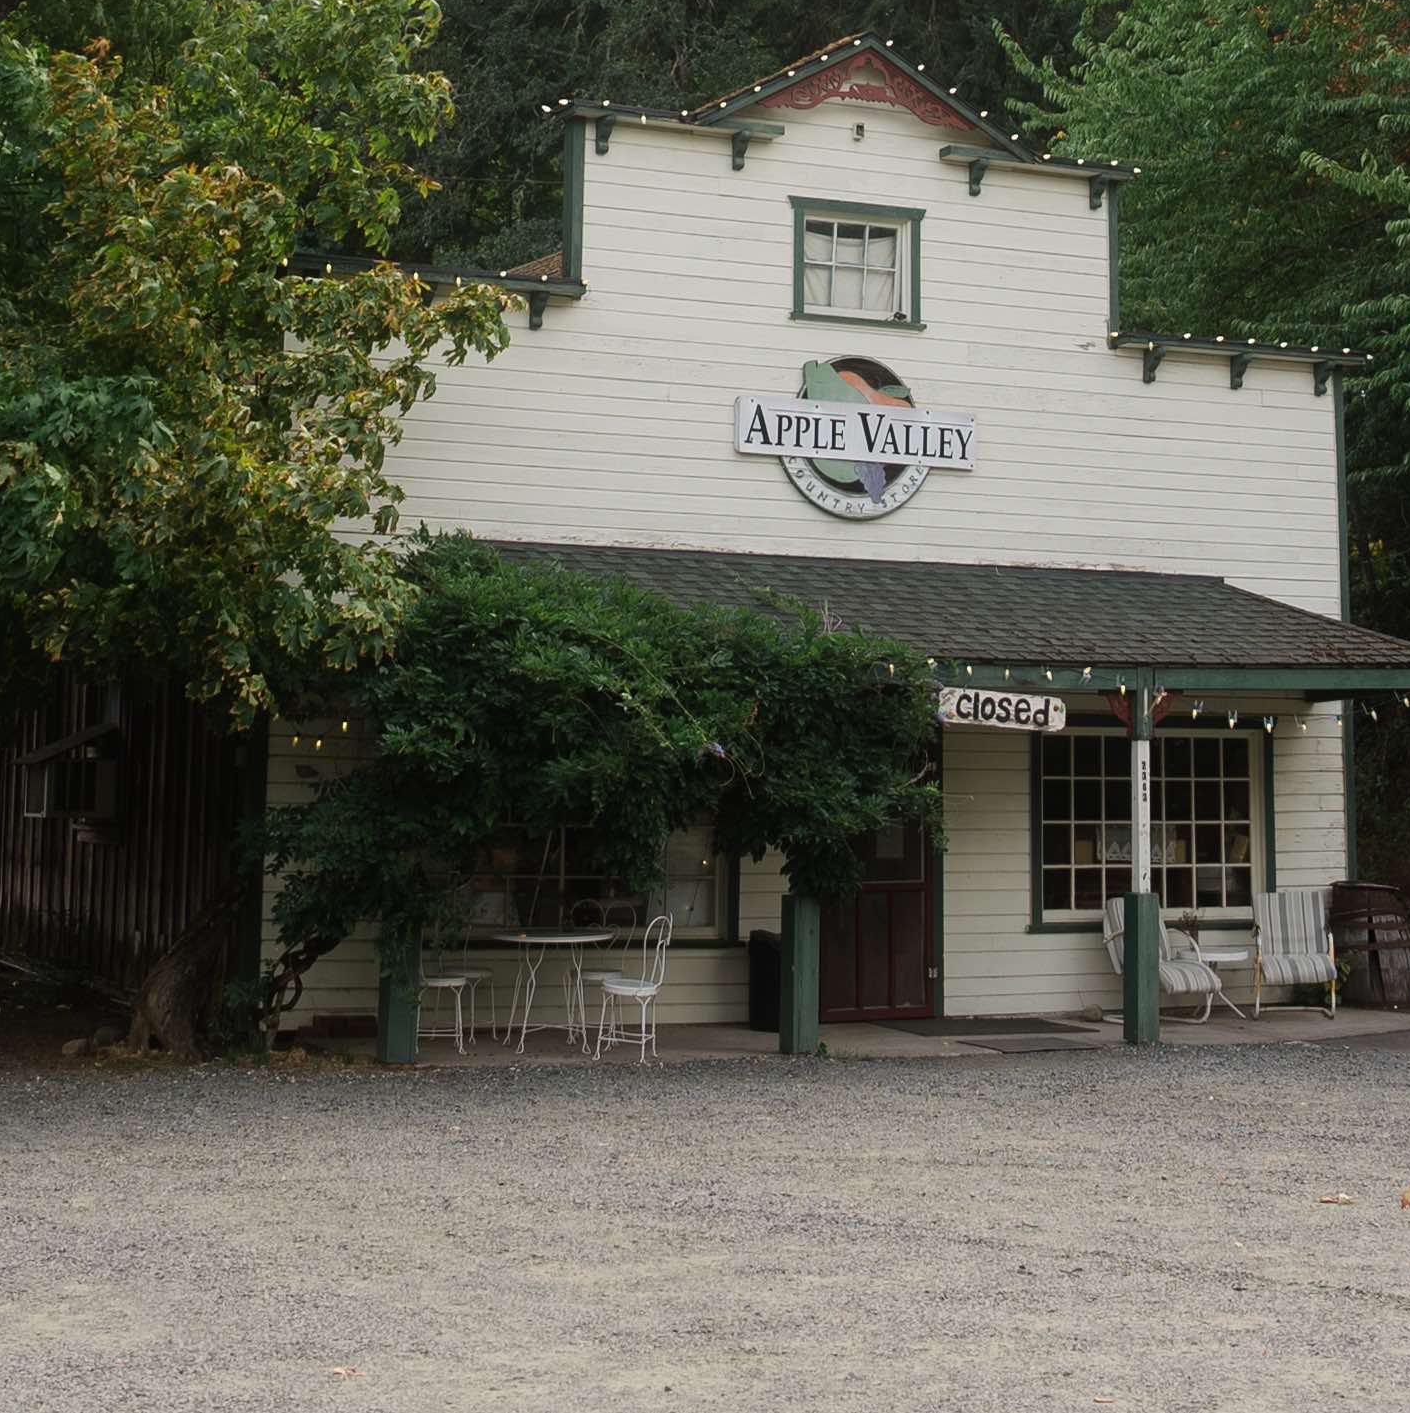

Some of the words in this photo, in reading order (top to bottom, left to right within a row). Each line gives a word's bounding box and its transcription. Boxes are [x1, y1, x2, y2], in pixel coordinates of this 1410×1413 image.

[744, 403, 847, 452] APPLE
[856, 411, 974, 461] VALLEY
[788, 455, 866, 514] COUNTRY
[880, 466, 925, 509] STORE
